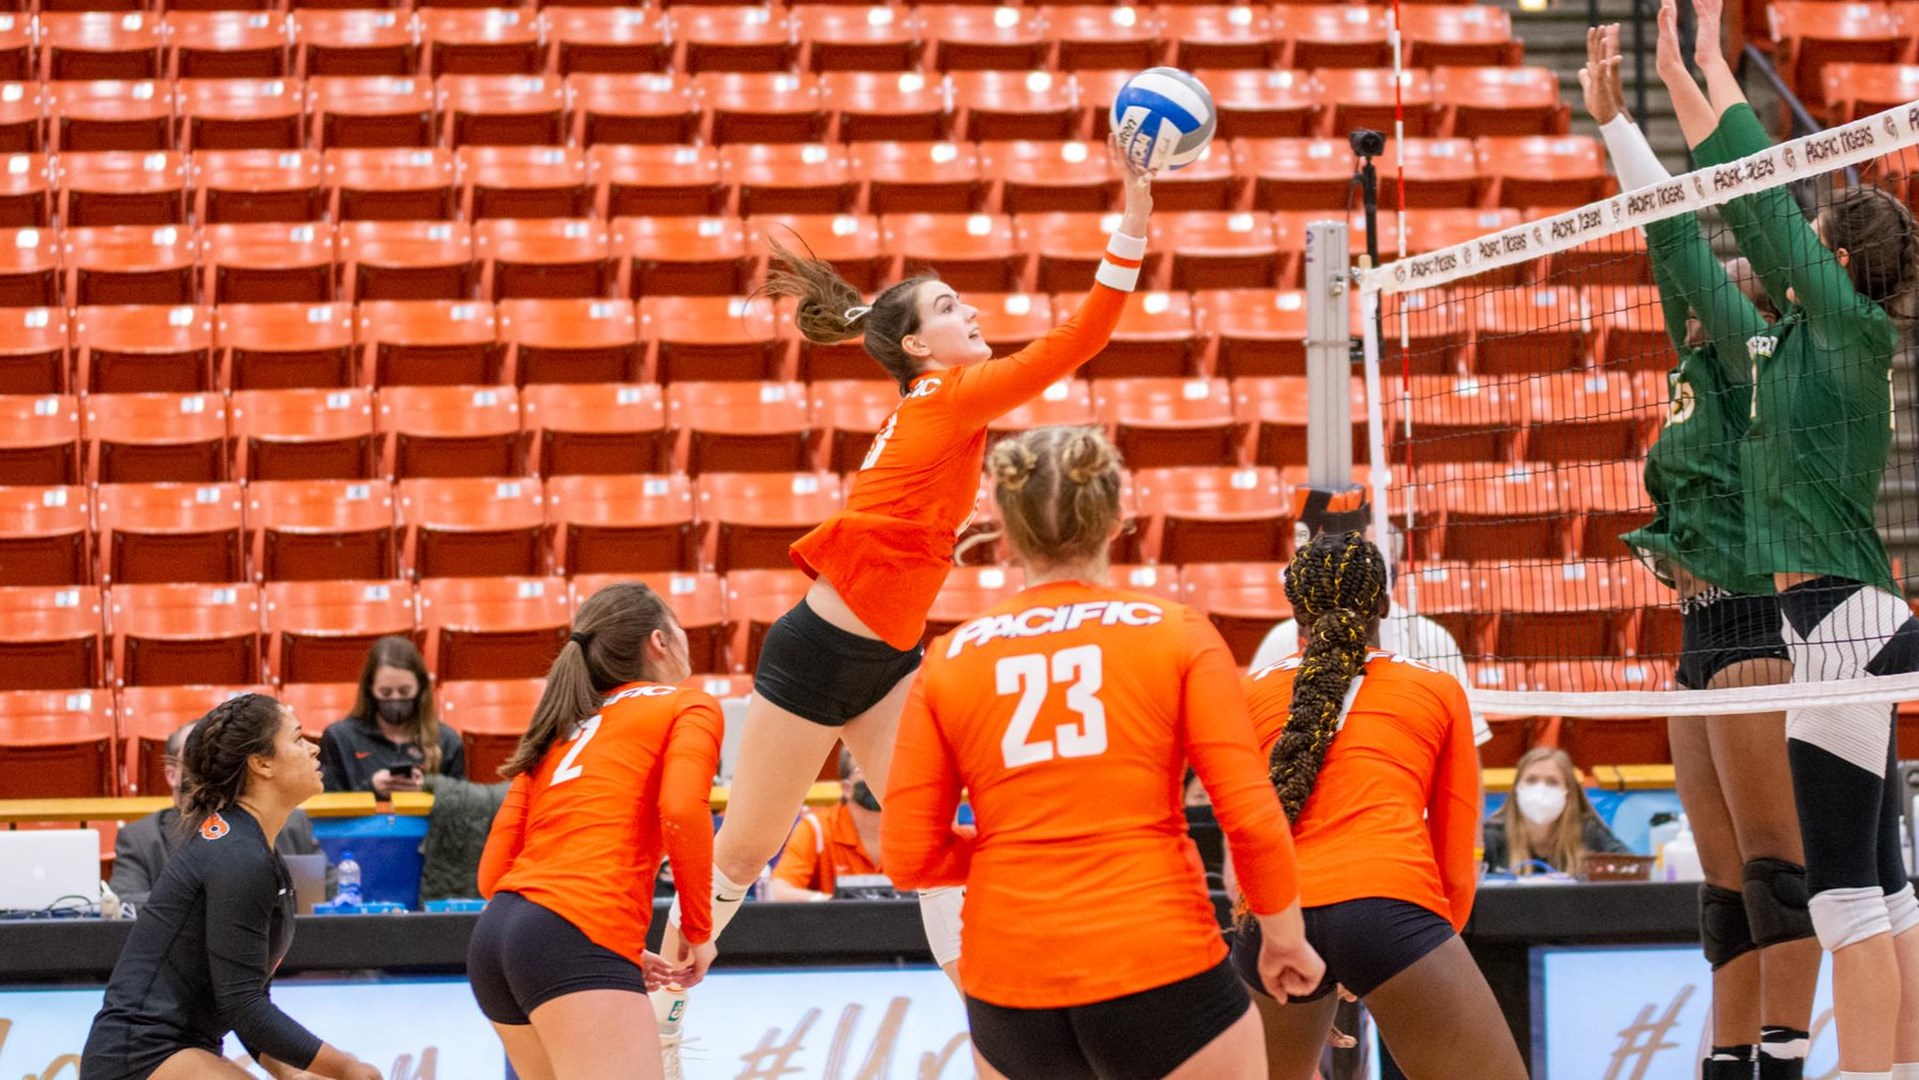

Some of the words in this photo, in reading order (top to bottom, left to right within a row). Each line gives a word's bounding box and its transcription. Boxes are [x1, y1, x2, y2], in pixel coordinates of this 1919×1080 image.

[1805, 137, 1839, 164] PACIFIC
[1839, 125, 1875, 153] TIGERS
[945, 601, 1164, 660] PACIFIC
[995, 643, 1108, 769] 23
[549, 714, 603, 787] 2
